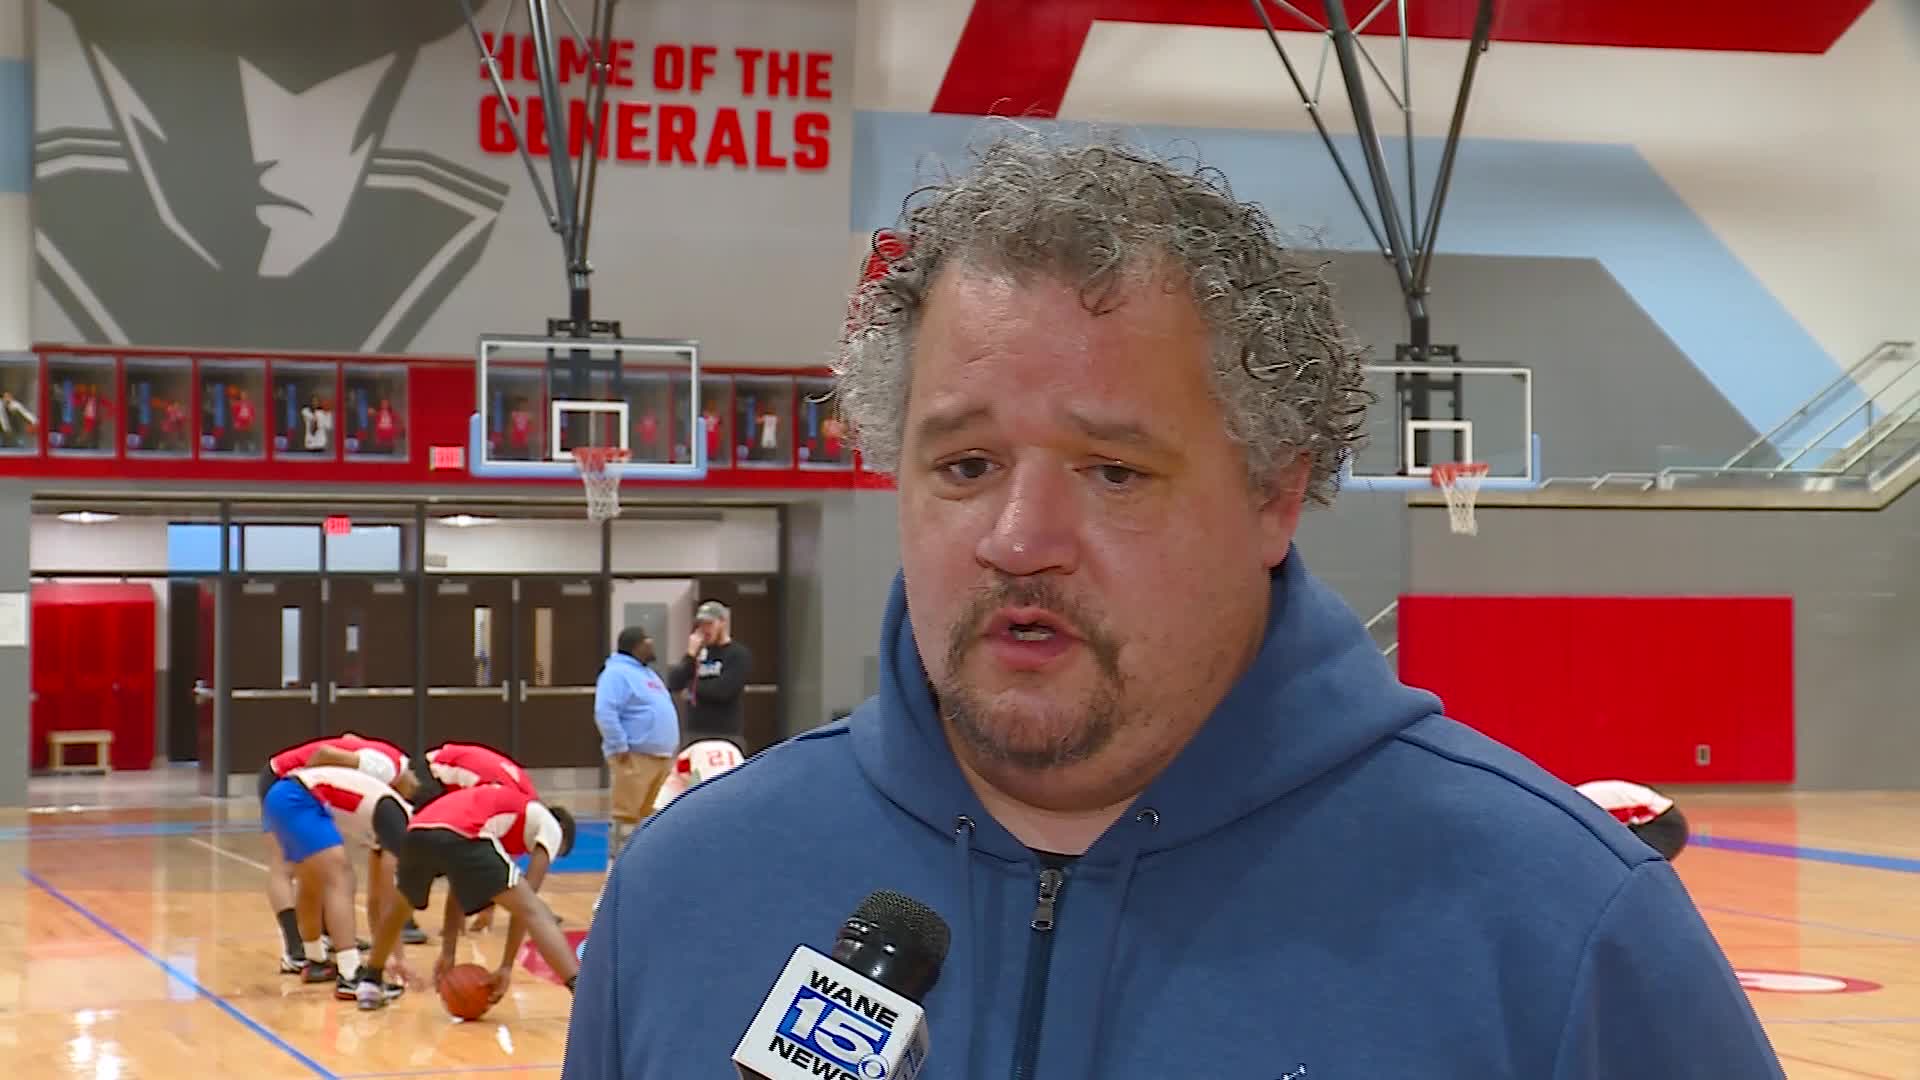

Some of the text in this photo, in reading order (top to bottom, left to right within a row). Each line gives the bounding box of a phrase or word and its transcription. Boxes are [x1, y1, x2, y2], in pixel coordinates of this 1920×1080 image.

[653, 44, 718, 92] OF
[736, 48, 833, 99] THE
[479, 94, 831, 170] GENERALS
[783, 990, 887, 1067] 15
[809, 970, 899, 1029] WANE
